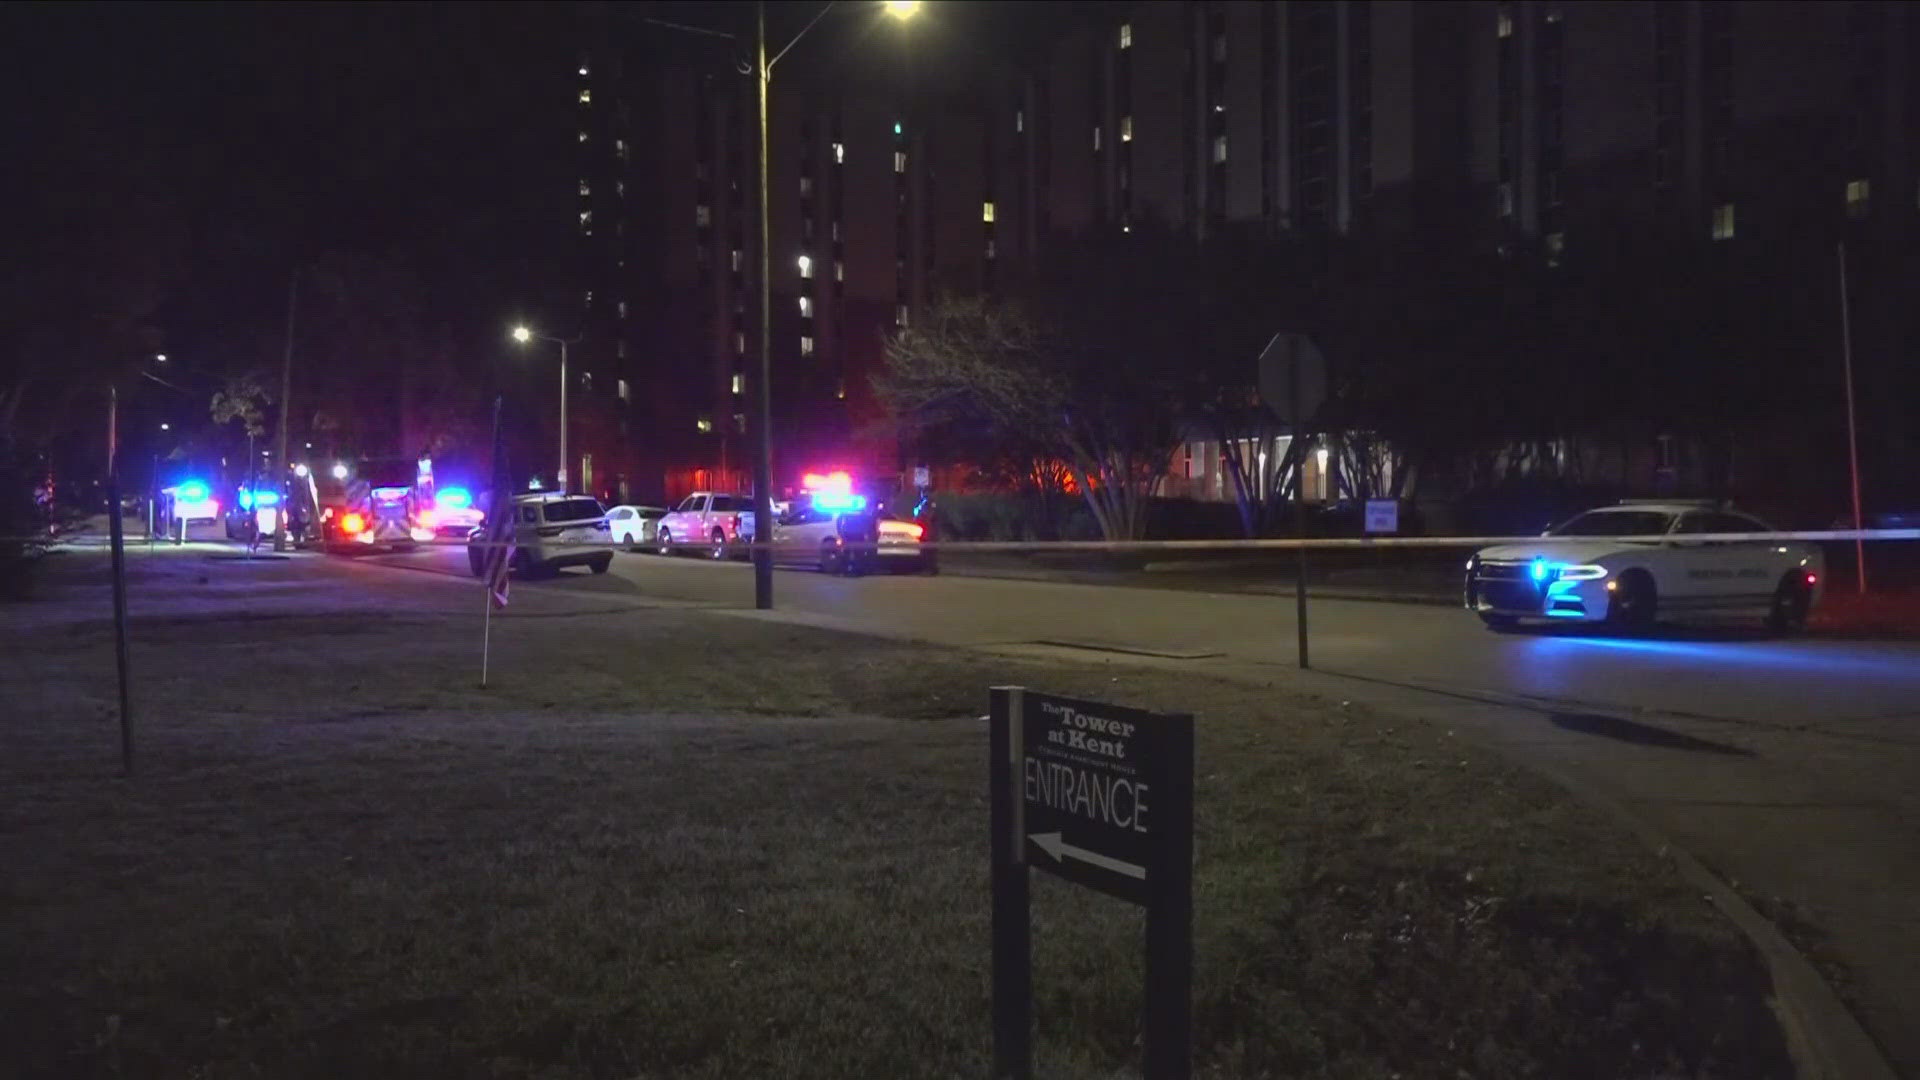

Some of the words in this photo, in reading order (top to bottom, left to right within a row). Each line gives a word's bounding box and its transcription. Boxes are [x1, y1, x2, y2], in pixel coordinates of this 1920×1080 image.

[1041, 702, 1060, 714] The
[1060, 707, 1135, 737] Tower
[1048, 730, 1065, 744] at
[1068, 729, 1125, 758] Kent
[1025, 757, 1148, 833] ENTRANCE
